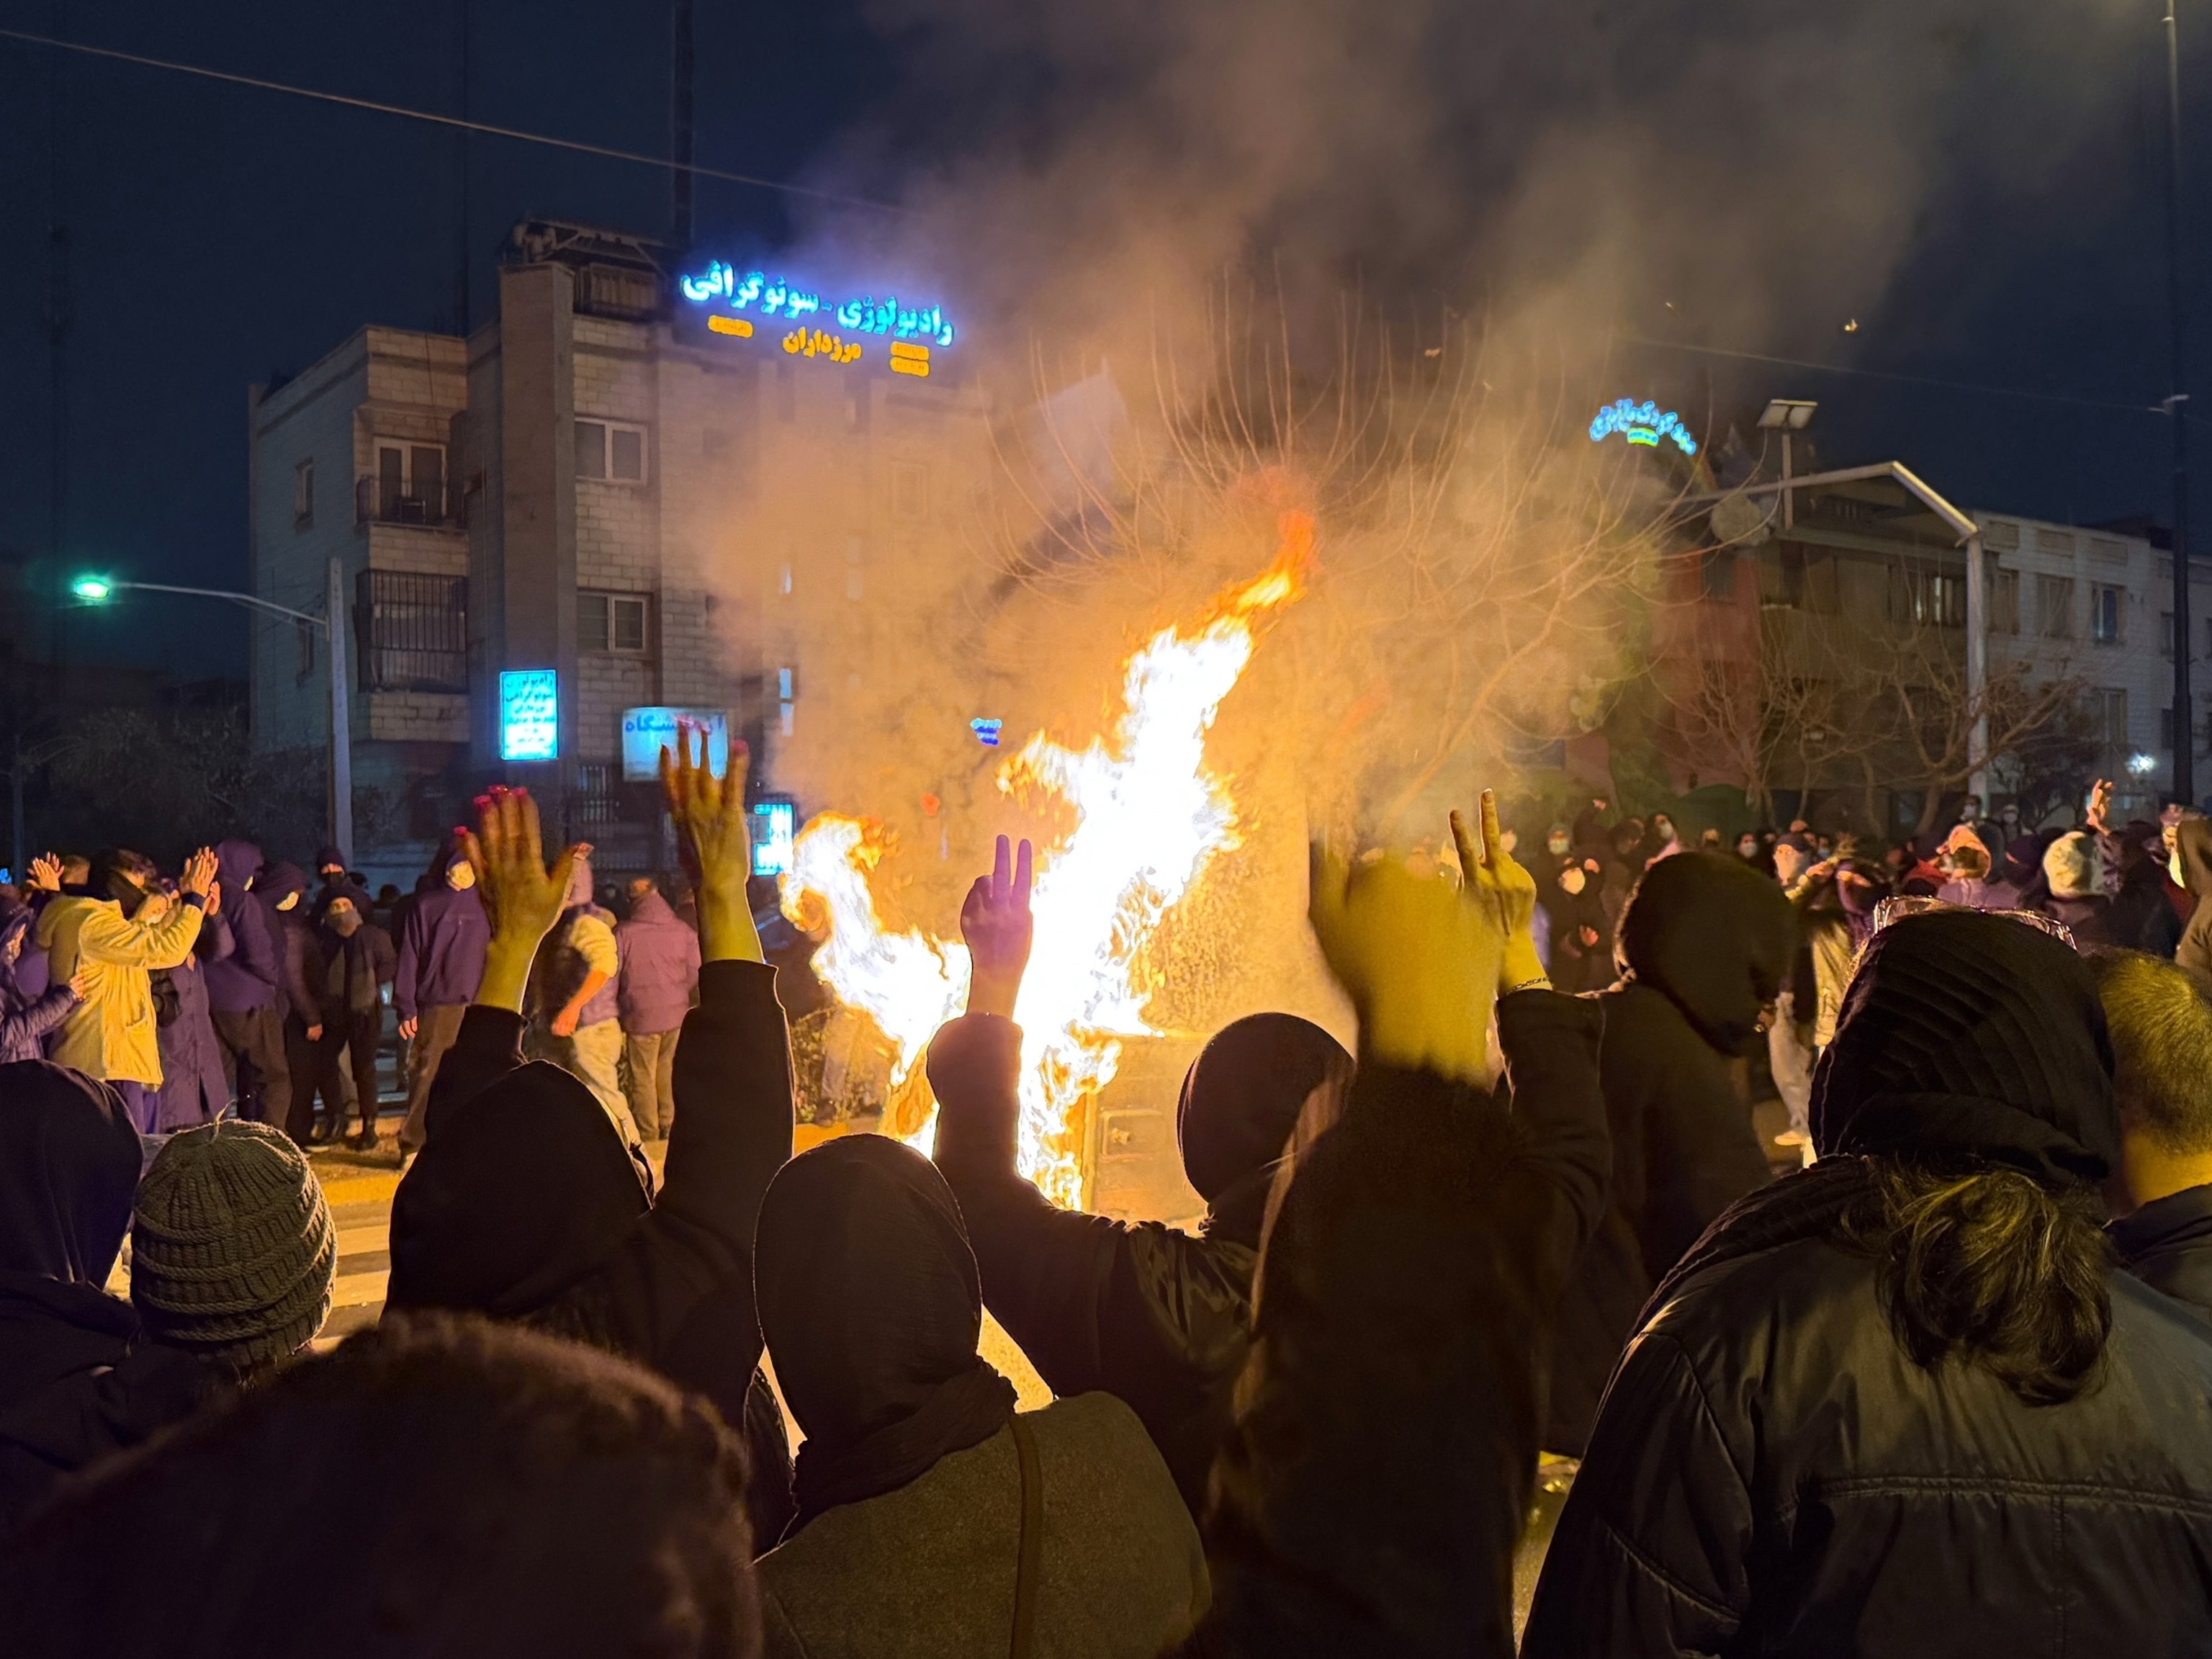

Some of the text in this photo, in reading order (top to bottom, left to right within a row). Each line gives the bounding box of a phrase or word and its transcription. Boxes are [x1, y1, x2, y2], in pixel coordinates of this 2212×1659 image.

[681, 261, 819, 318] سونوگرافی
[783, 326, 862, 364] مرزداران
[837, 295, 954, 346] رادیولوژی
